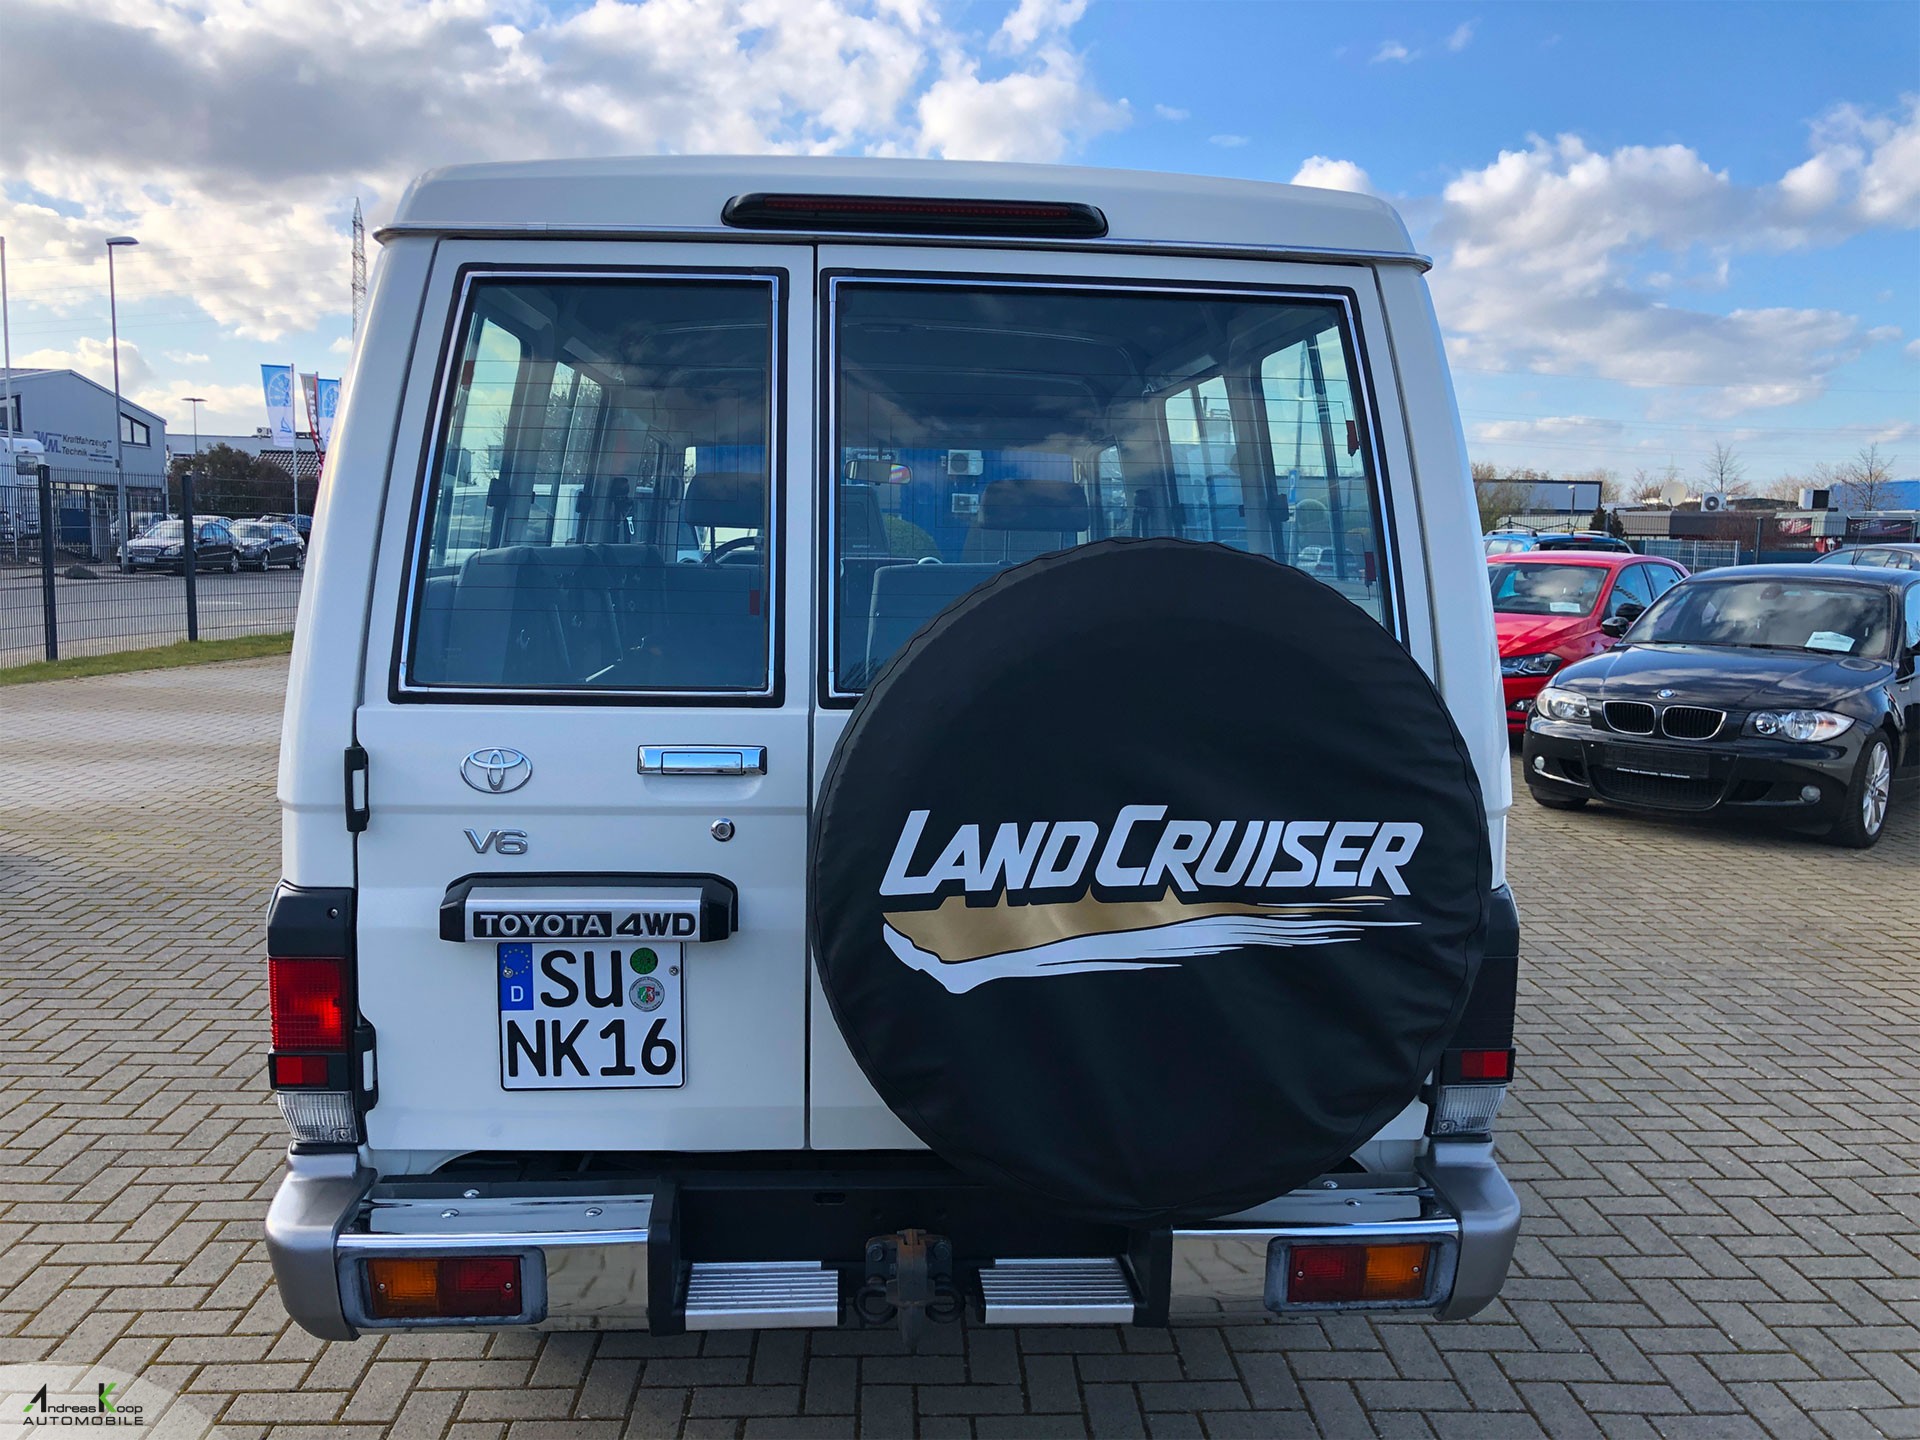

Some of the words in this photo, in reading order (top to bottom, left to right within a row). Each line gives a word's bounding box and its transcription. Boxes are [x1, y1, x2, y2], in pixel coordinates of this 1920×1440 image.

[62, 446, 88, 456] Technik
[463, 828, 528, 855] V6
[480, 914, 606, 936] TOYOTA
[615, 912, 697, 937] 4WD
[540, 949, 624, 1008] SU
[510, 985, 525, 1003] D
